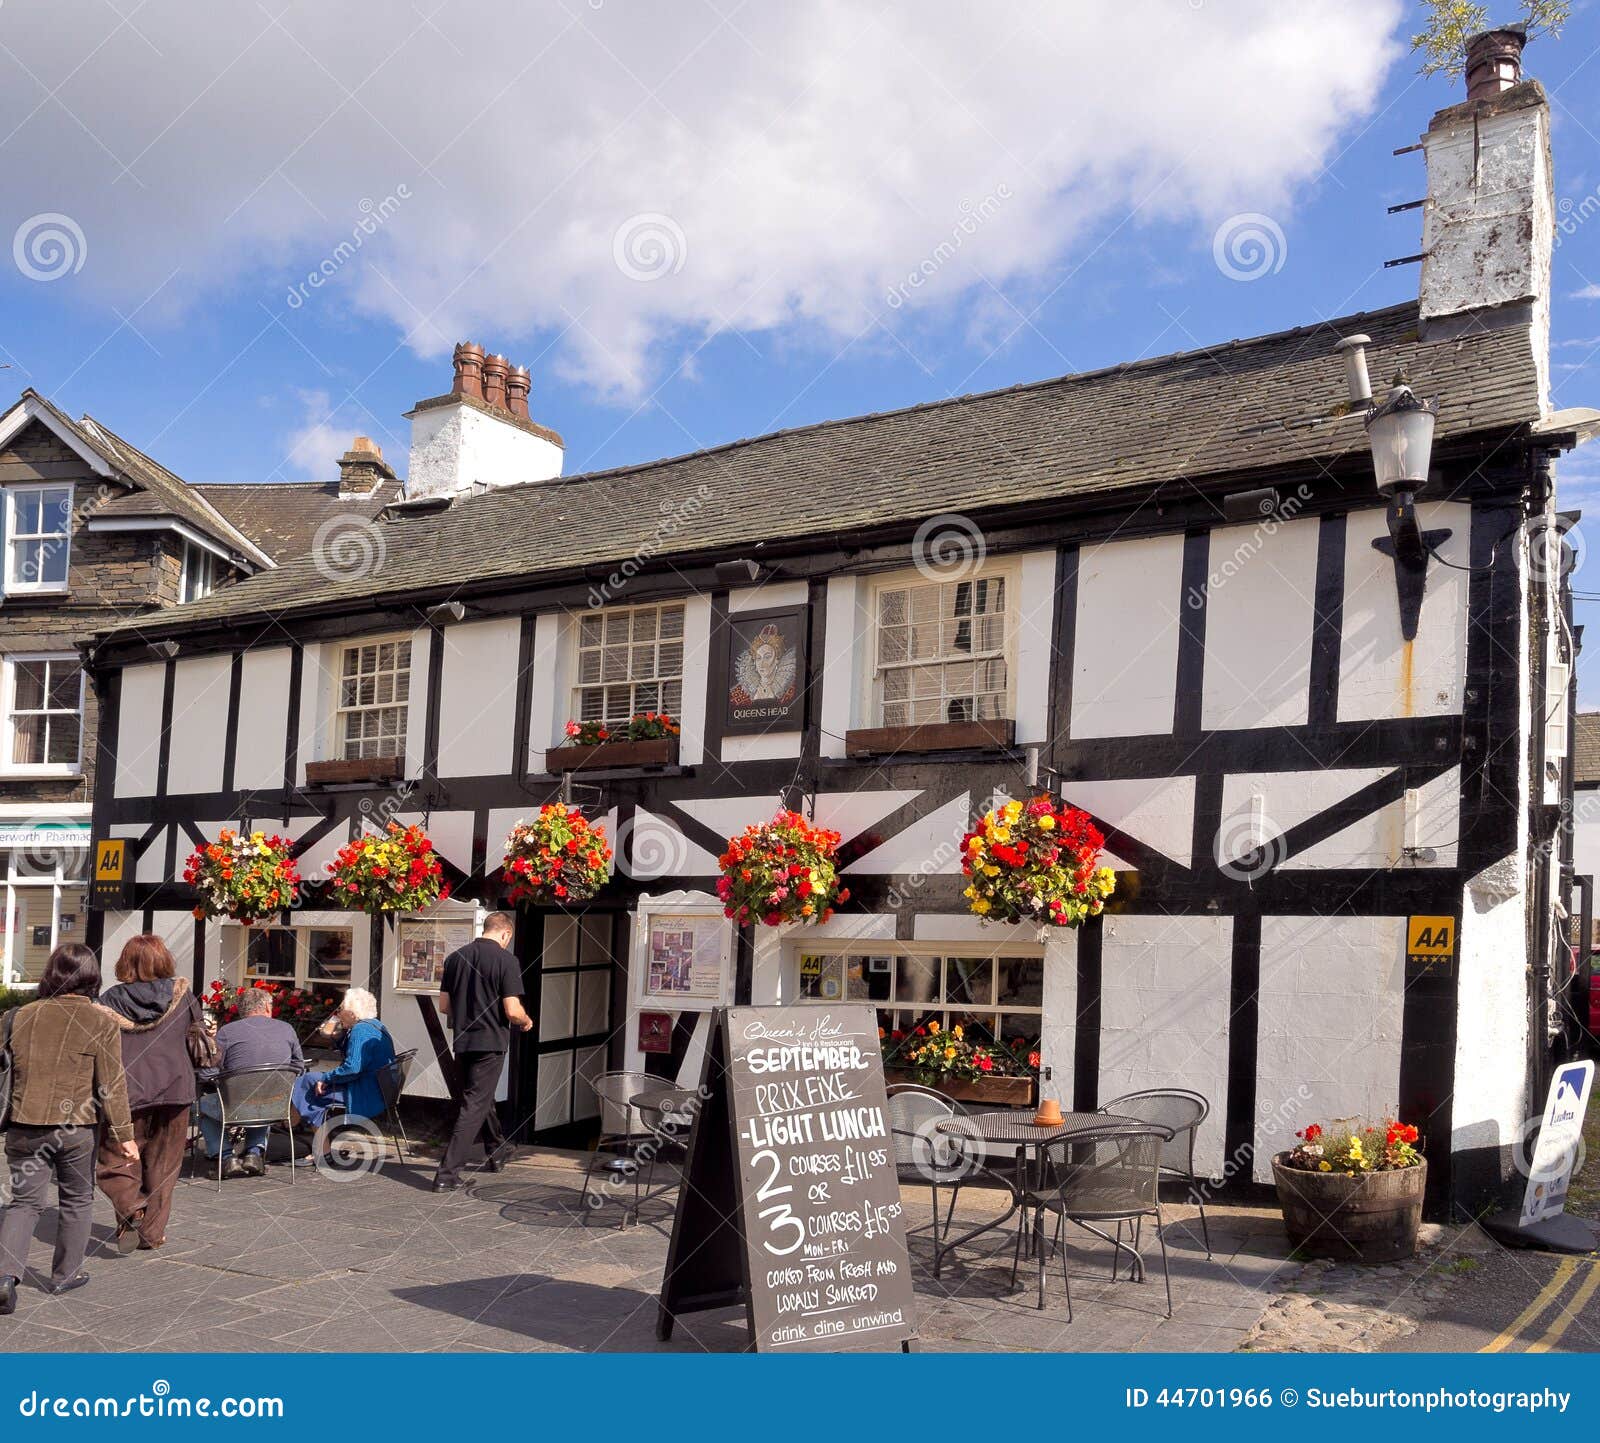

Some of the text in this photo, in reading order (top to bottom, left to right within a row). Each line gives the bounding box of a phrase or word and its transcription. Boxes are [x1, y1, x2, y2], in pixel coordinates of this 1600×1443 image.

[733, 706, 789, 719] QUEENS HEAD
[100, 850, 120, 871] AA
[1414, 927, 1449, 948] AA
[803, 957, 819, 970] AA
[743, 1014, 867, 1047] Queen's Head
[819, 1107, 886, 1141] LUNCH
[750, 1149, 793, 1203] 2
[789, 1154, 841, 1177] COURSES
[808, 1182, 831, 1200] OR
[758, 1203, 805, 1256] 3
[808, 1210, 862, 1238] COURSES
[766, 1259, 897, 1289] COOKED FROM FRESH AND
[776, 1283, 878, 1314] LOCALLY SOURCED
[771, 1308, 903, 1342] drink dine unwind
